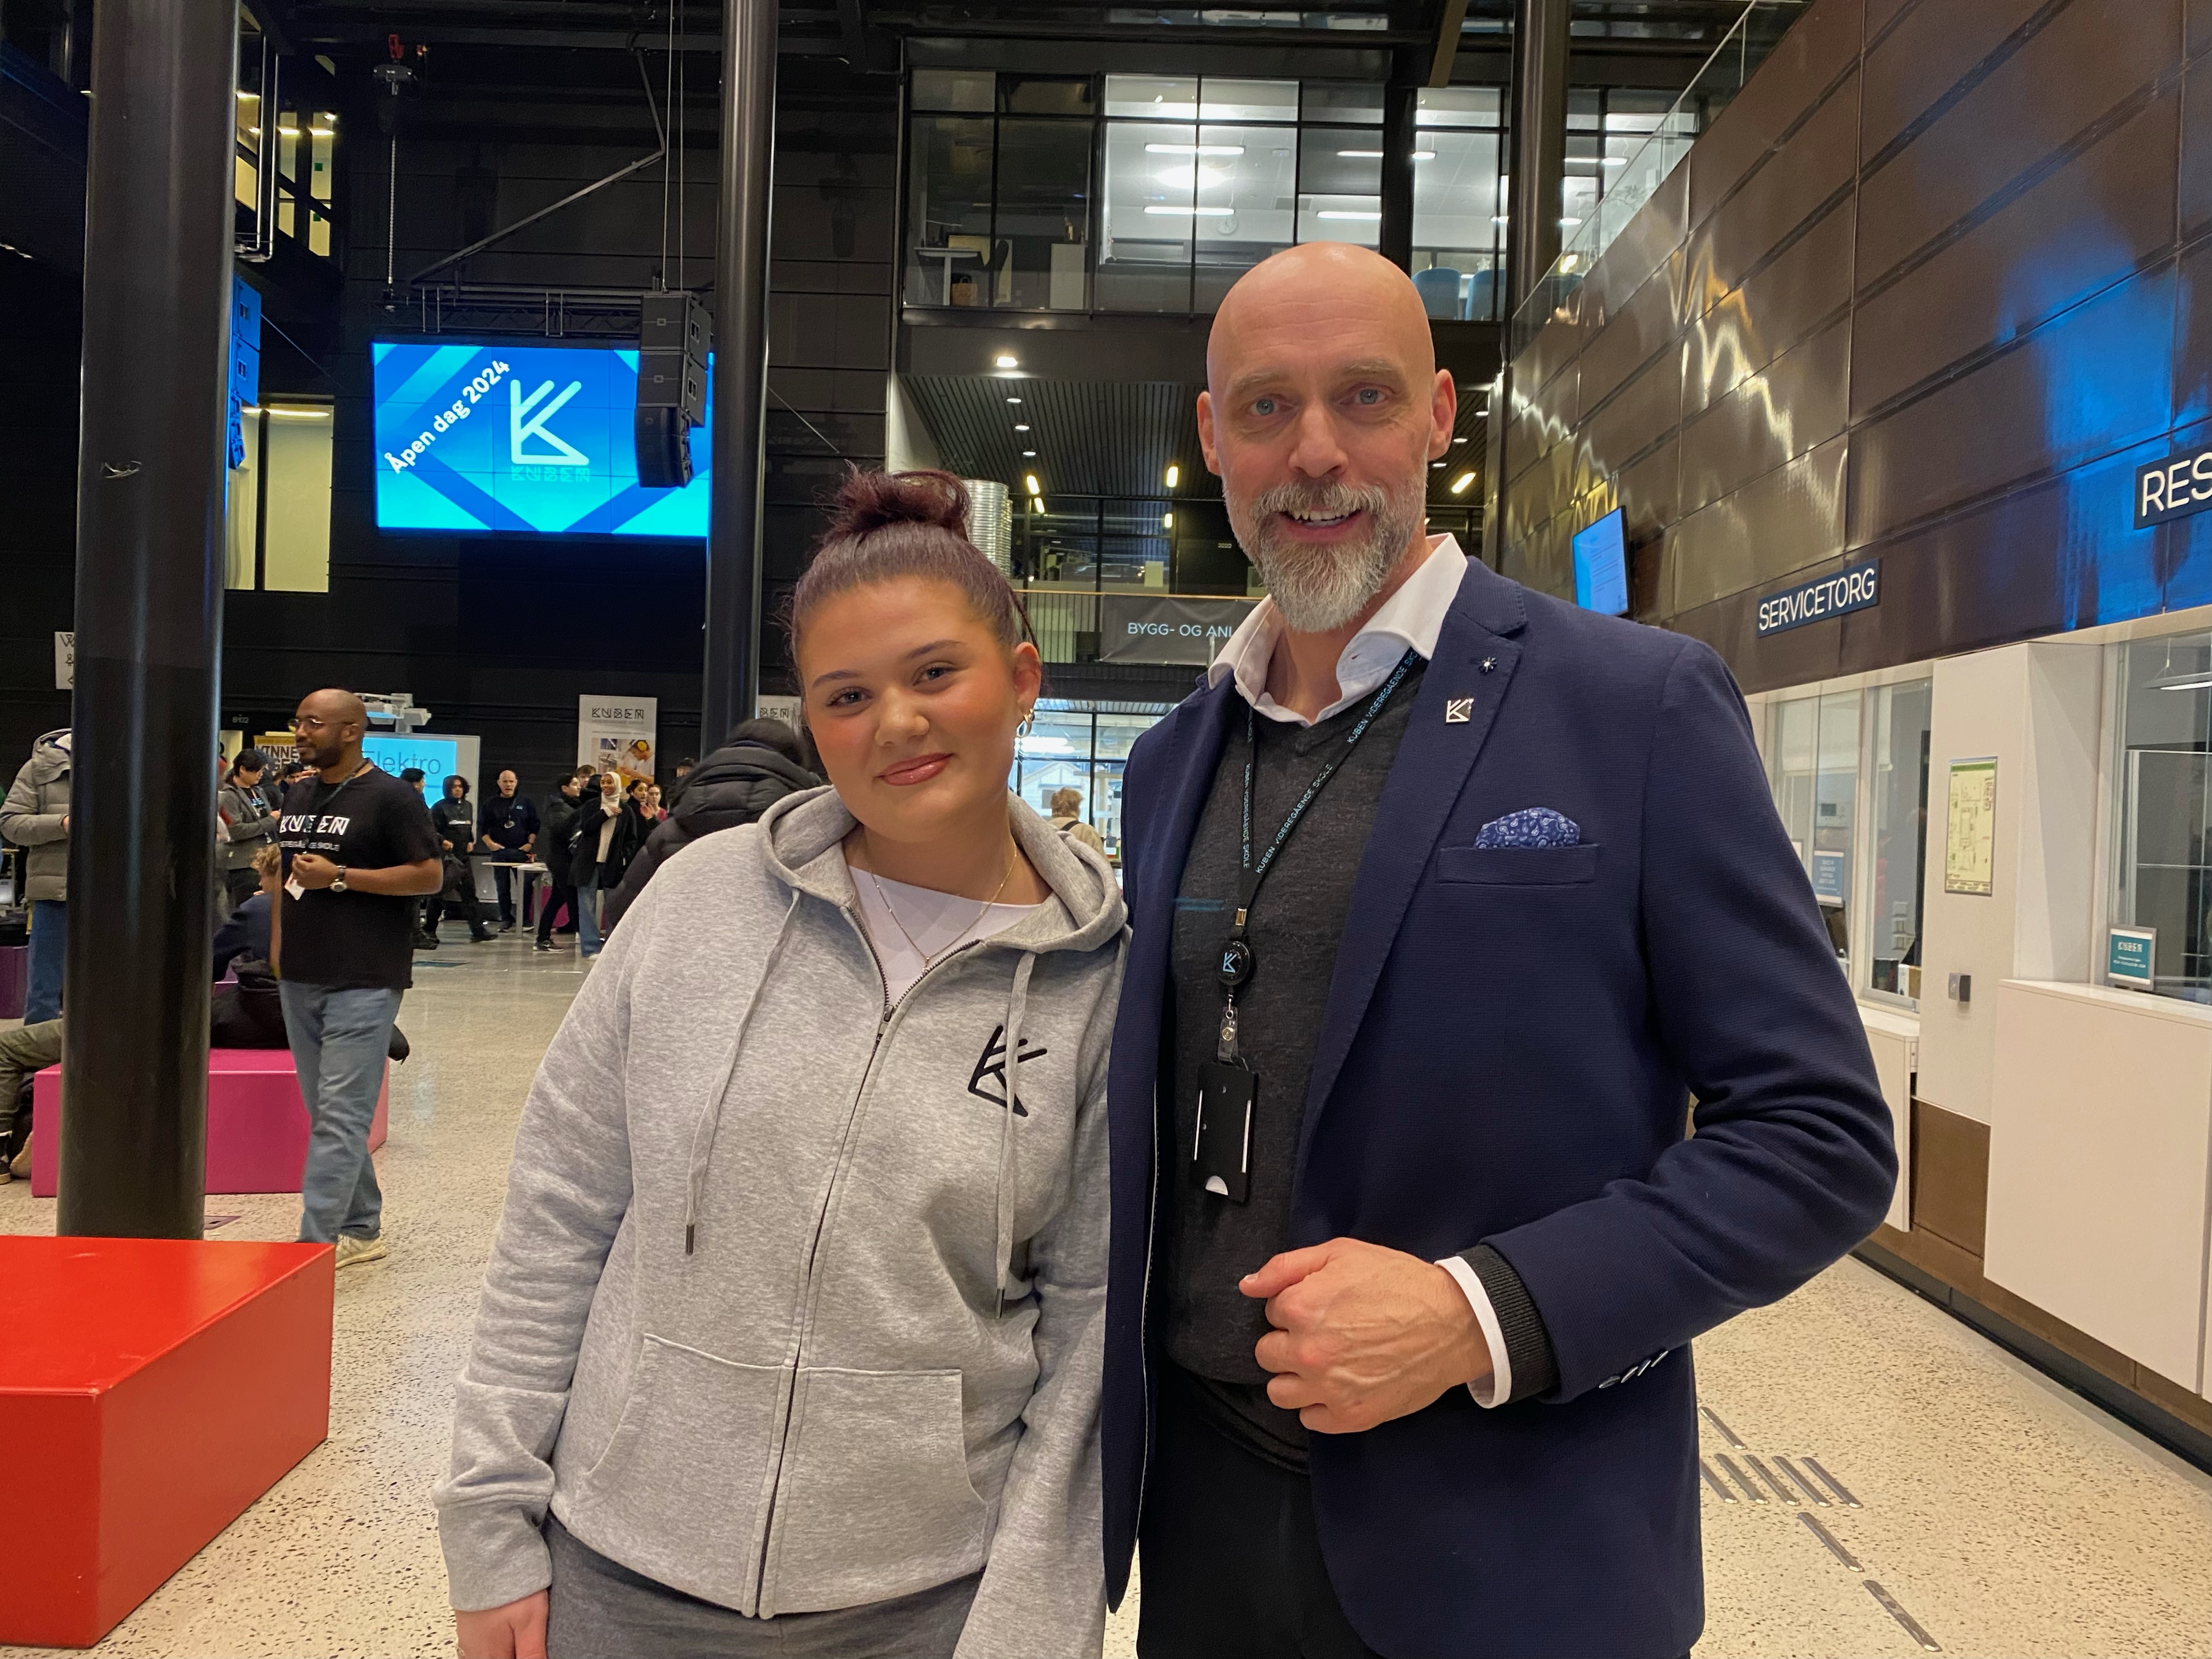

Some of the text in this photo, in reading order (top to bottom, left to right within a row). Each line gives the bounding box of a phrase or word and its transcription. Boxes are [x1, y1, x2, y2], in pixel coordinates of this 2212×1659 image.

[384, 360, 510, 474] Åpen dag 2024
[2142, 452, 2212, 517] RES
[1759, 568, 1875, 631] SERVICETORG
[1127, 623, 1175, 635] BYGG-
[1179, 624, 1202, 637] OG
[592, 707, 644, 719] KUBEN
[1346, 718, 1368, 743] KUBEN
[362, 750, 441, 774] lektro
[1255, 764, 1333, 873] KUBEN VIDEREGÅENDE SKOLE
